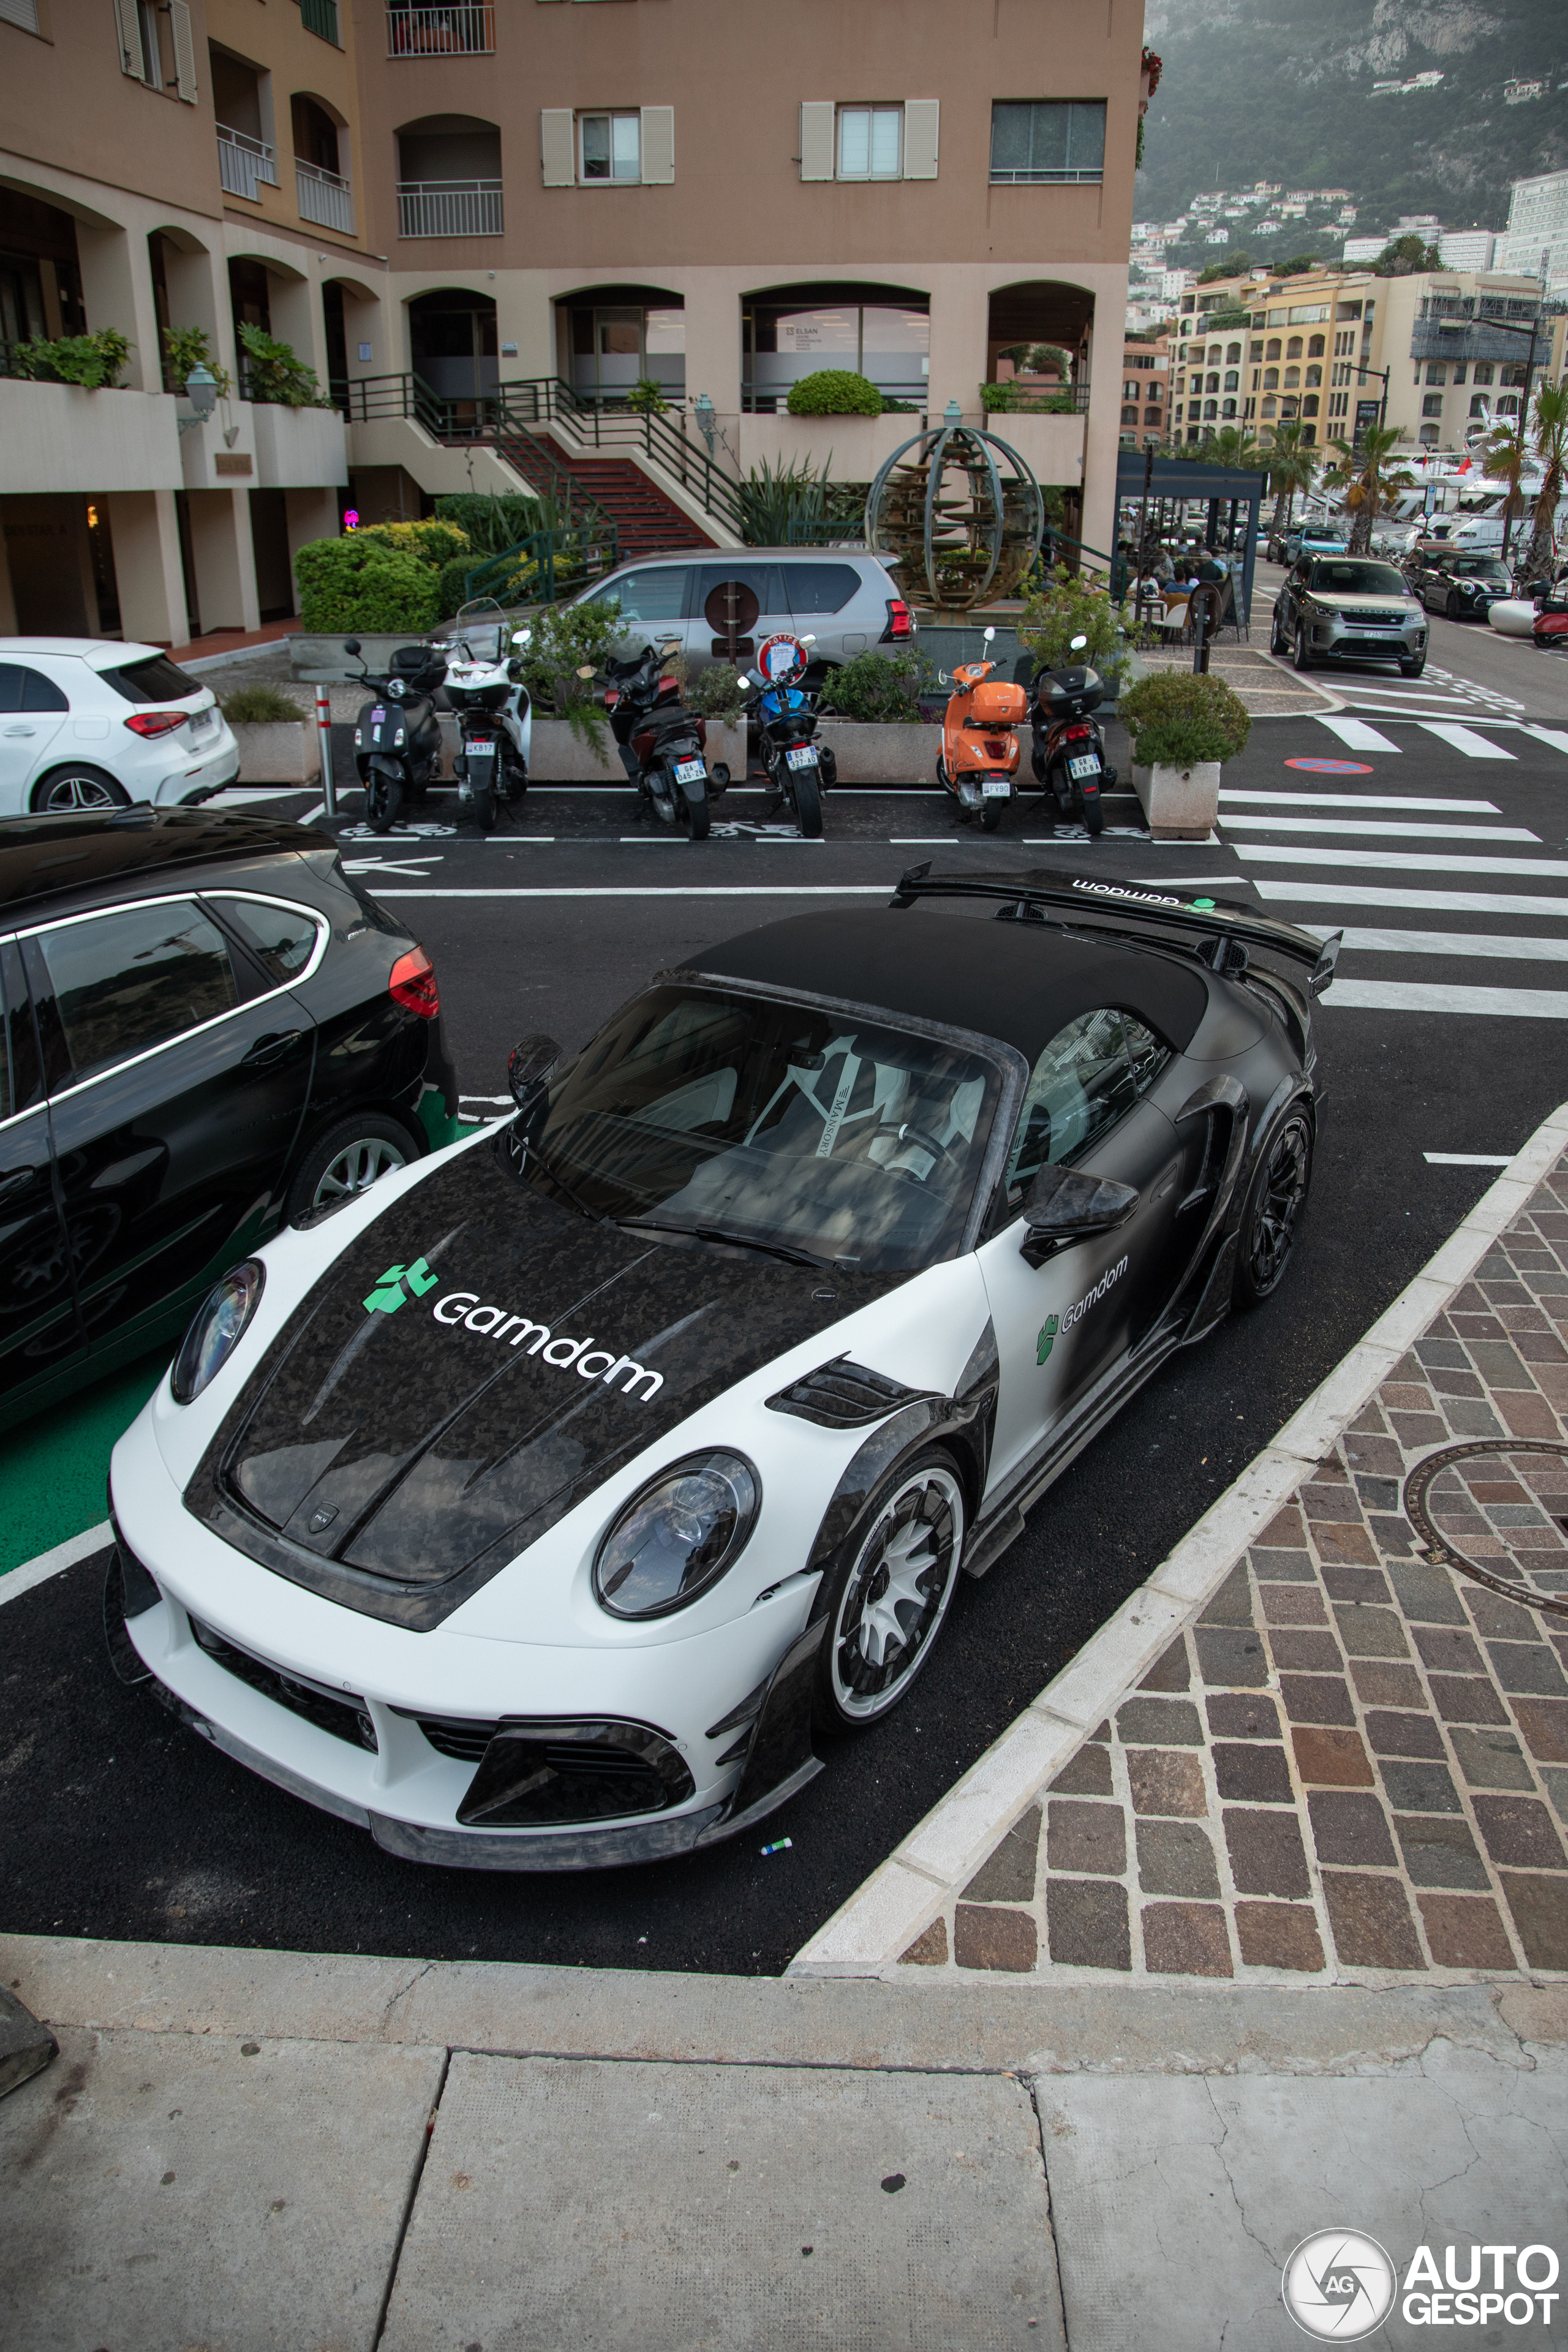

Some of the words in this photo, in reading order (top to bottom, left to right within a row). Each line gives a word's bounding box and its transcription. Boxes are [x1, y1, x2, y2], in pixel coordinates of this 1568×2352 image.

[767, 635, 798, 646] POLICE
[1072, 879, 1180, 906] Gamdom
[820, 1099, 845, 1156] MANSORY
[1061, 1255, 1128, 1334] Gamdom
[432, 1292, 664, 1403] Gamdom
[863, 1523, 879, 1552] MANSORY
